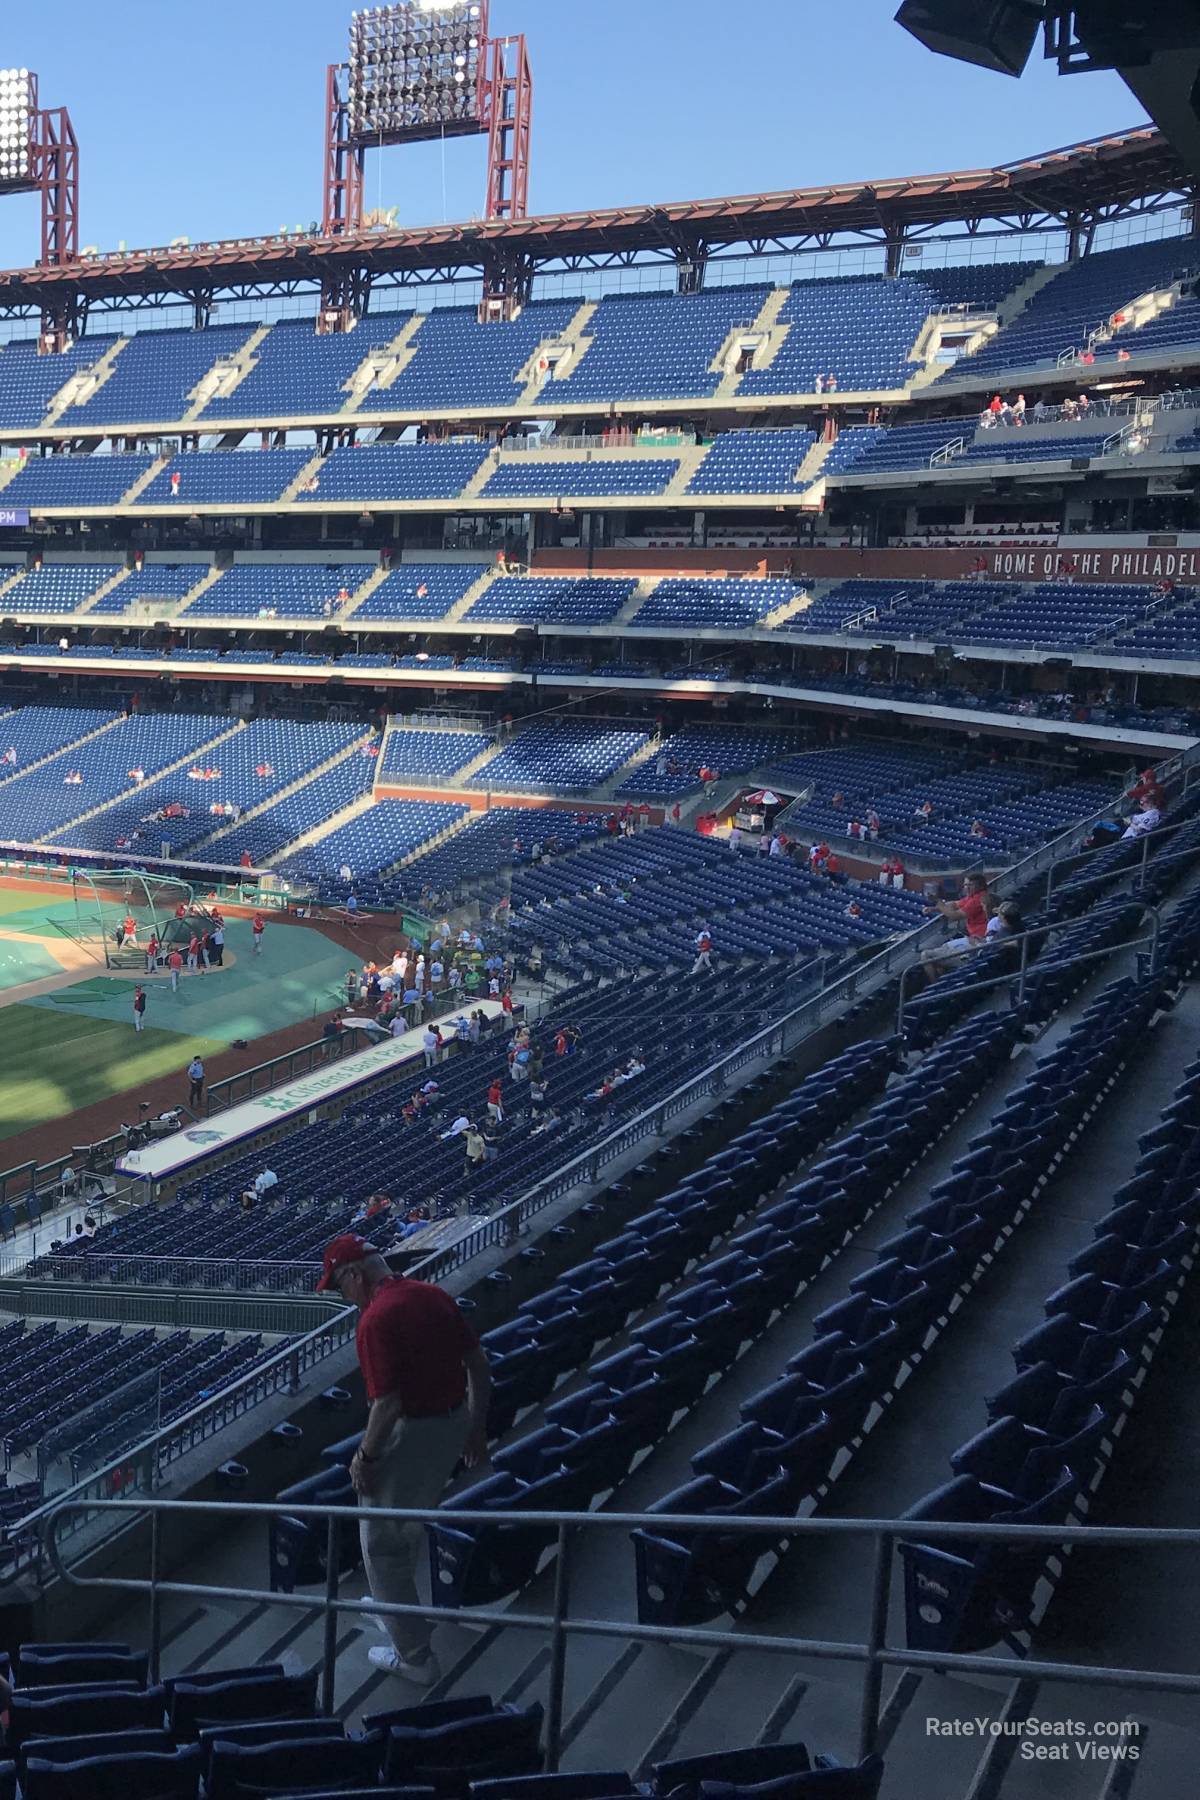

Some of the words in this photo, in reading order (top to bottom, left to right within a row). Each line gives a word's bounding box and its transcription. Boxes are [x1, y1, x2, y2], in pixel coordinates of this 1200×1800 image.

[0, 511, 16, 524] PM
[994, 553, 1036, 574] HOME
[1072, 553, 1101, 575] THE
[1111, 553, 1197, 576] PHILADEL
[285, 1066, 353, 1099] Citizens
[342, 1054, 381, 1074] Bank
[377, 1042, 417, 1061] Park
